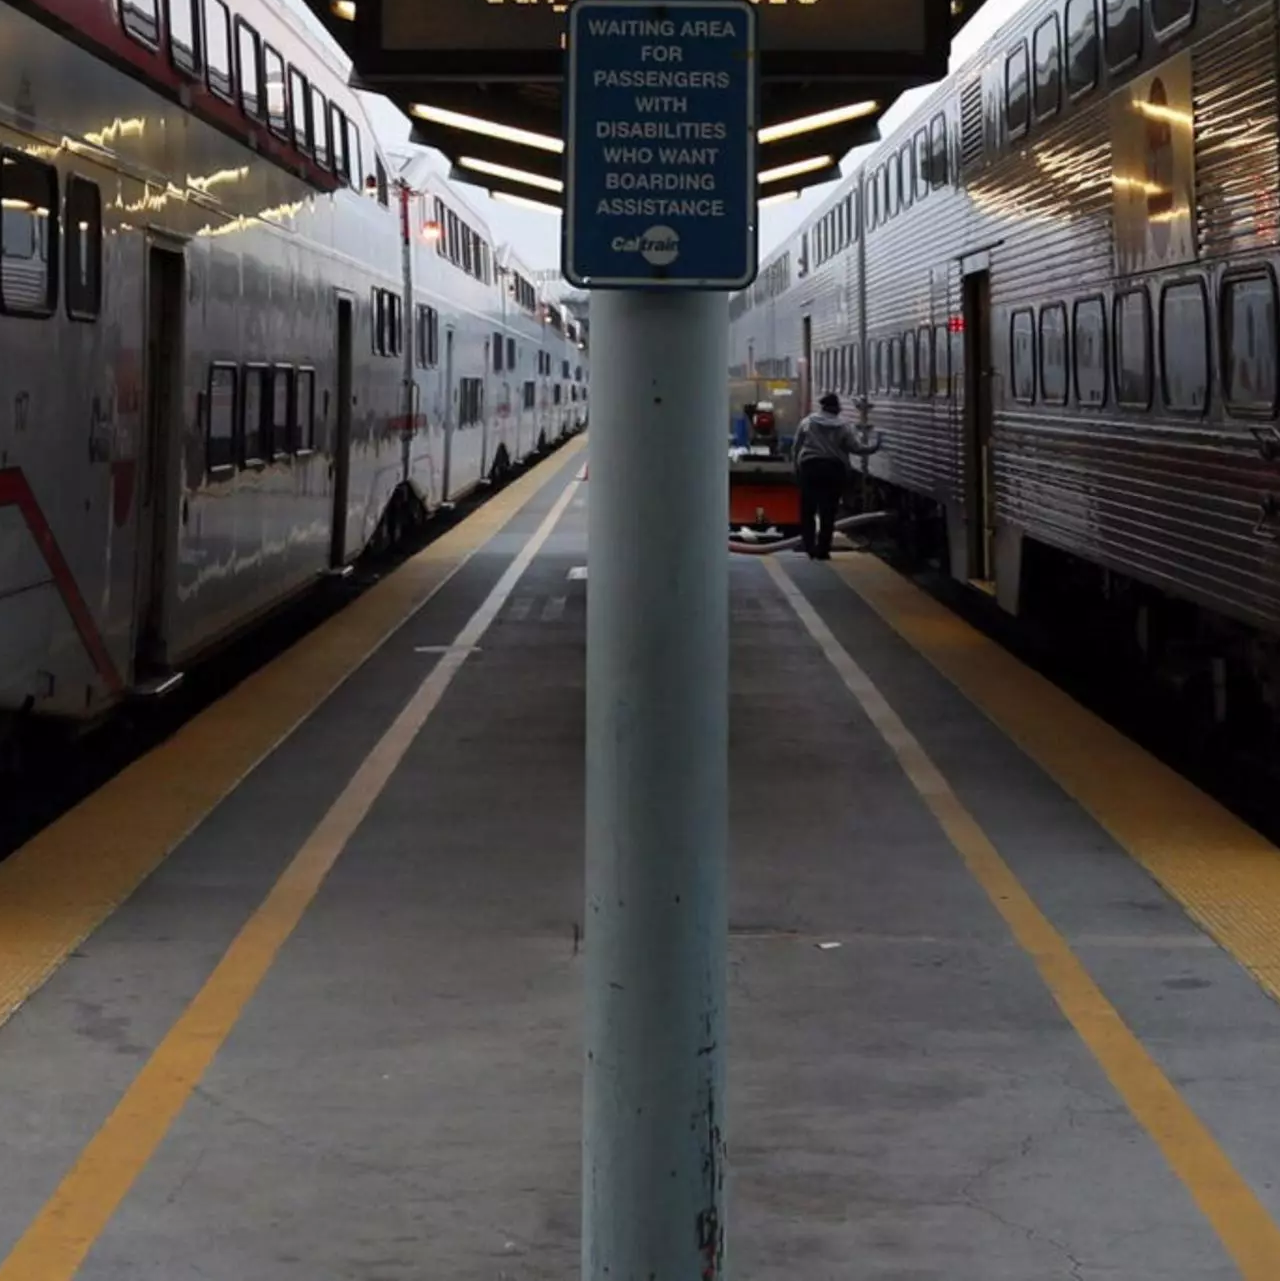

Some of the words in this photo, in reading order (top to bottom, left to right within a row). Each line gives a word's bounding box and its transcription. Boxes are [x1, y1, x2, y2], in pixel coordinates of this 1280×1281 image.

[589, 19, 674, 37] WAITING
[680, 19, 736, 37] AREA
[640, 45, 683, 62] FOR
[593, 71, 730, 89] PASSENGERS
[635, 96, 688, 113] WITH
[596, 121, 727, 139] DISABILITIES
[603, 147, 653, 164] WHO
[659, 148, 719, 165] WANT
[605, 173, 715, 191] BOARDING
[596, 199, 726, 217] ASSISTANCE
